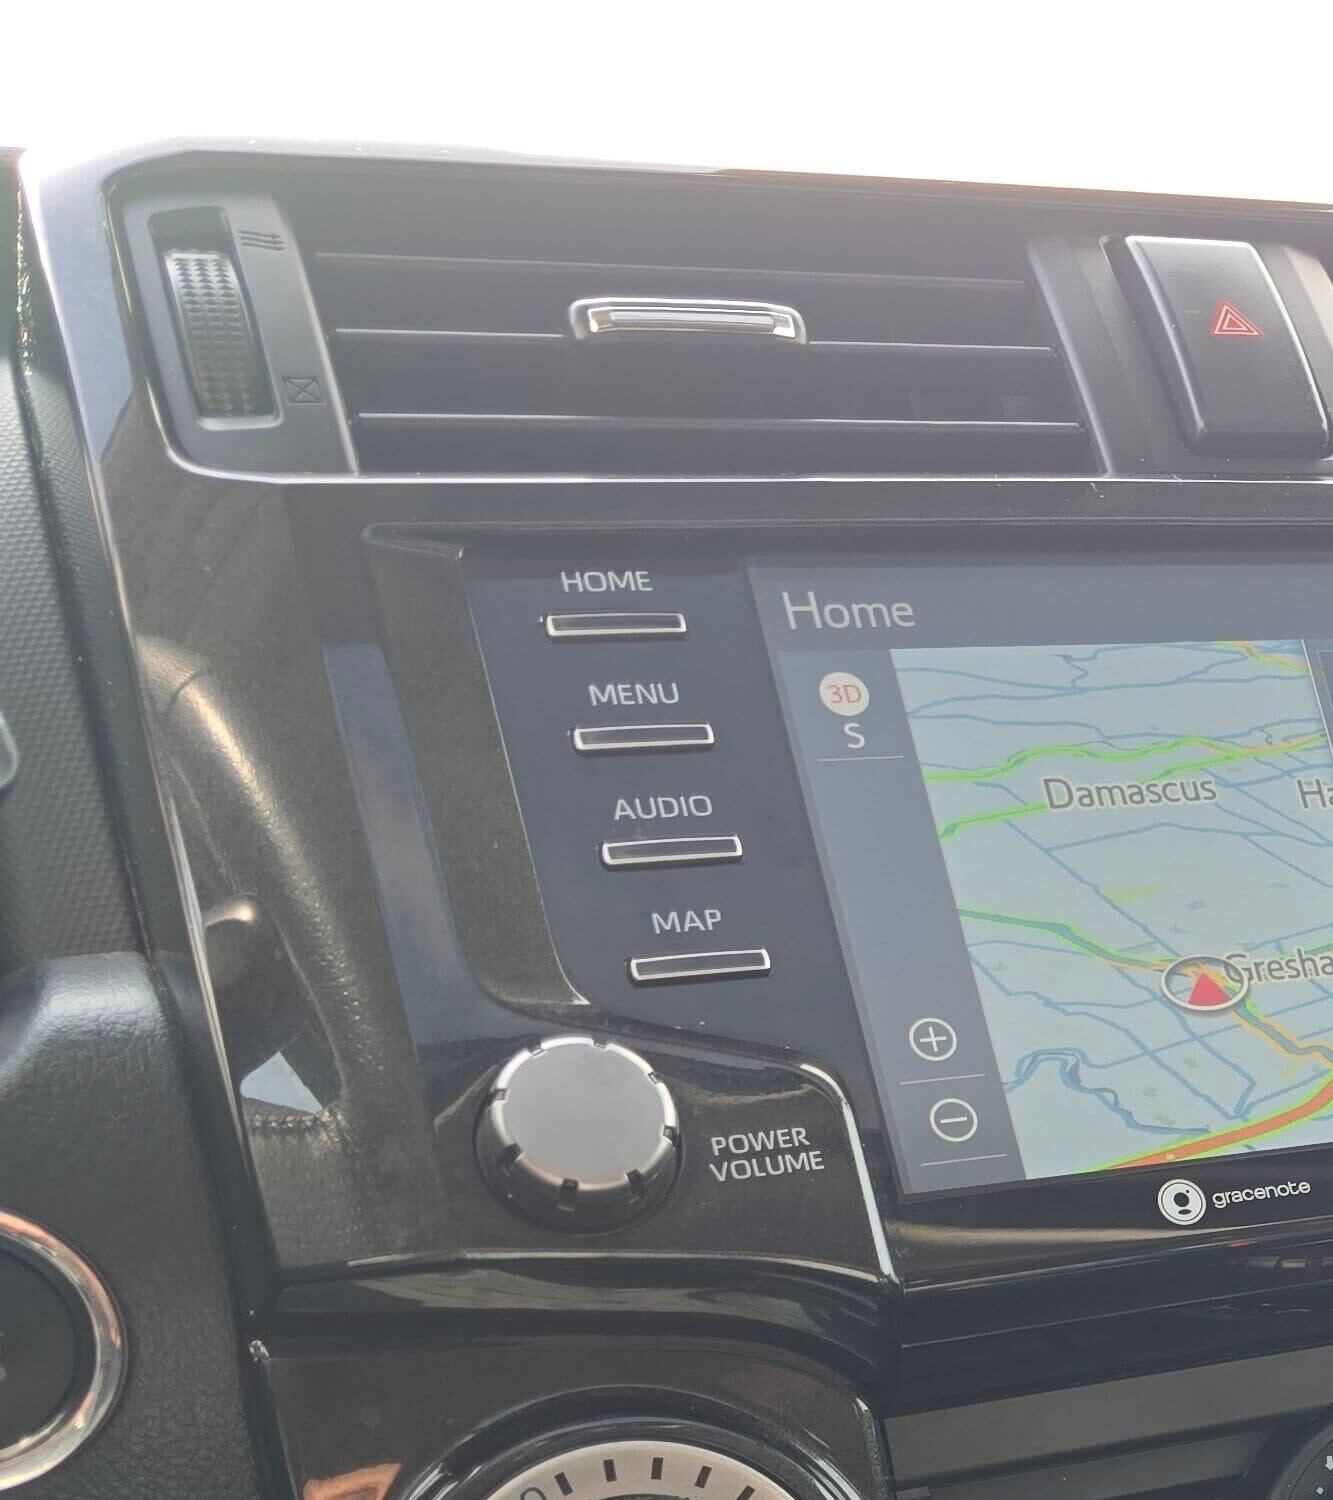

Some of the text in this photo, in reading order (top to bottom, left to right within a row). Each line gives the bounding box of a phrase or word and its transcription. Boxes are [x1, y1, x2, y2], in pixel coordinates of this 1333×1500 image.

[560, 570, 654, 593] HOME
[781, 591, 916, 629] Home
[588, 682, 680, 706] MENU
[826, 684, 863, 705] 3D
[843, 722, 866, 749] S
[1042, 777, 1218, 810] Damascus
[612, 794, 713, 821] AUDIO
[651, 908, 722, 934] MAP
[710, 1126, 811, 1156] POWER
[709, 1151, 826, 1182] VOLUME
[1211, 1180, 1312, 1209] gracenote
